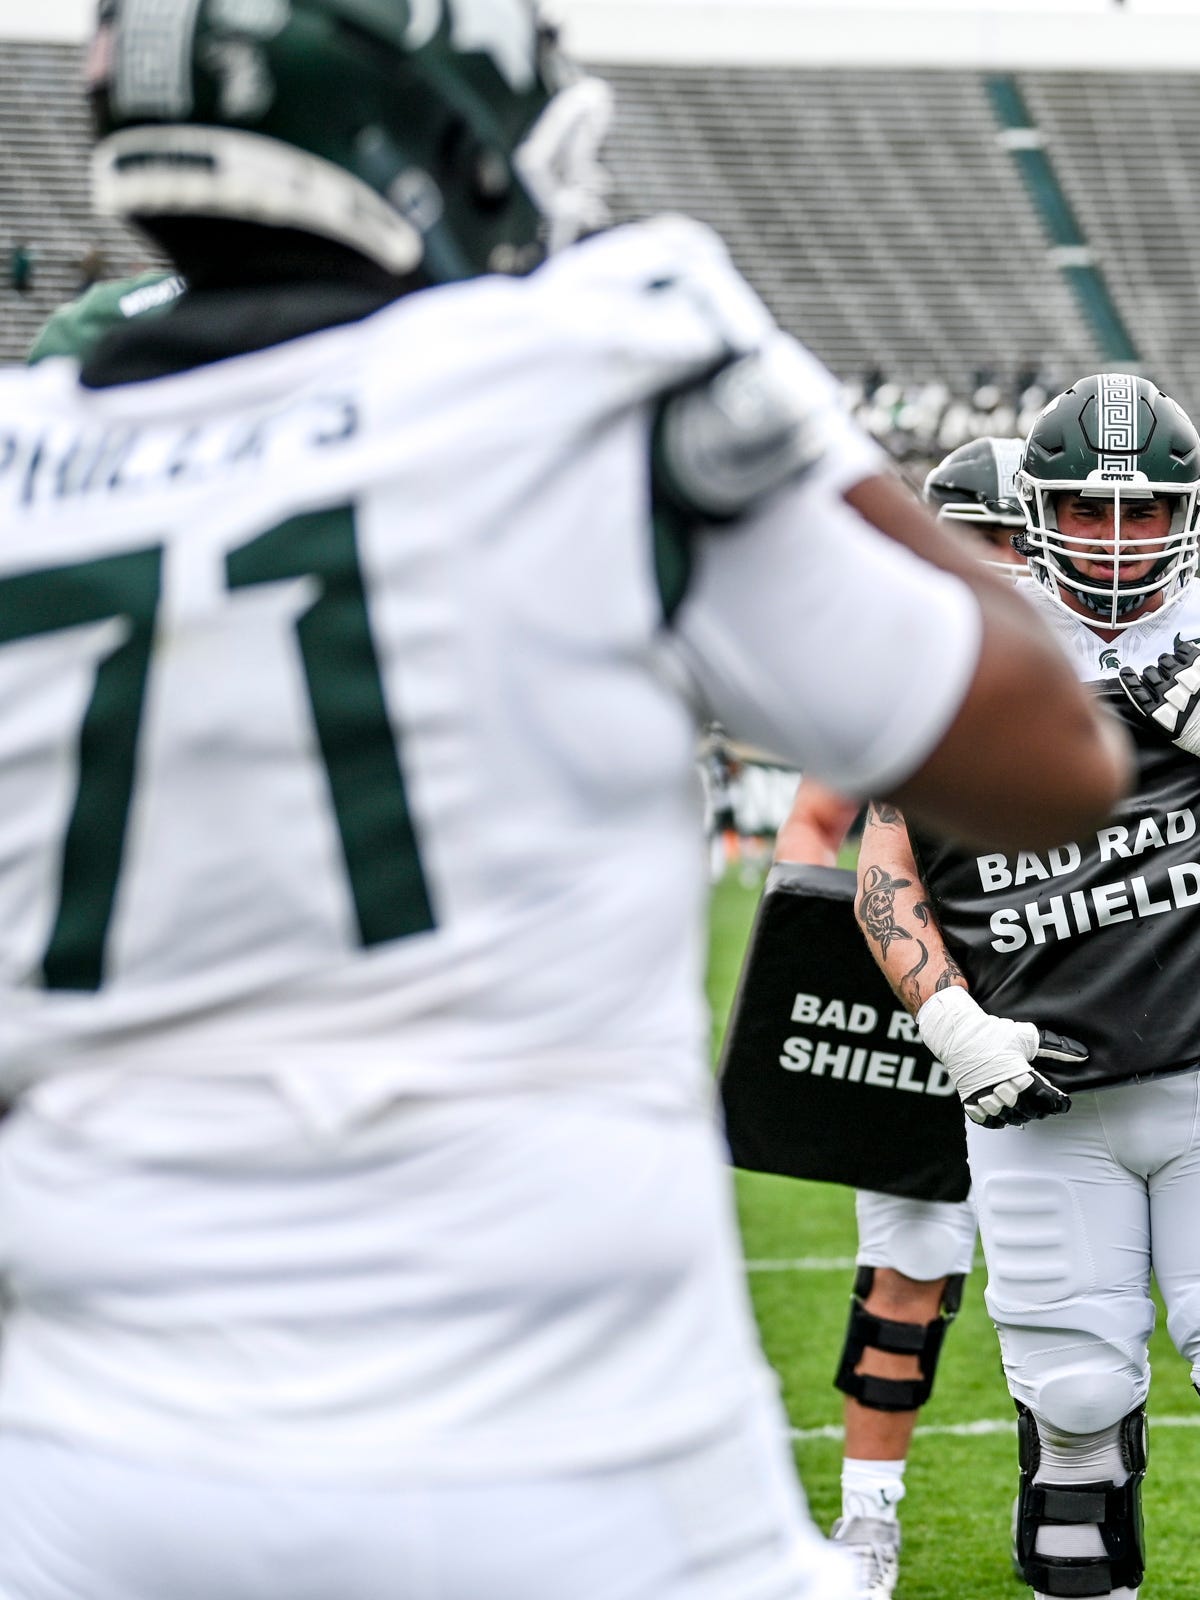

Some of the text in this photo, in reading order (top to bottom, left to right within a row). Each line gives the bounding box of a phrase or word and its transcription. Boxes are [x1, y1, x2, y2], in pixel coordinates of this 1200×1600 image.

[0, 502, 437, 992] 71
[976, 808, 1197, 893] BAD RAD
[790, 992, 878, 1035] BAD
[779, 1036, 957, 1097] SHIELD
